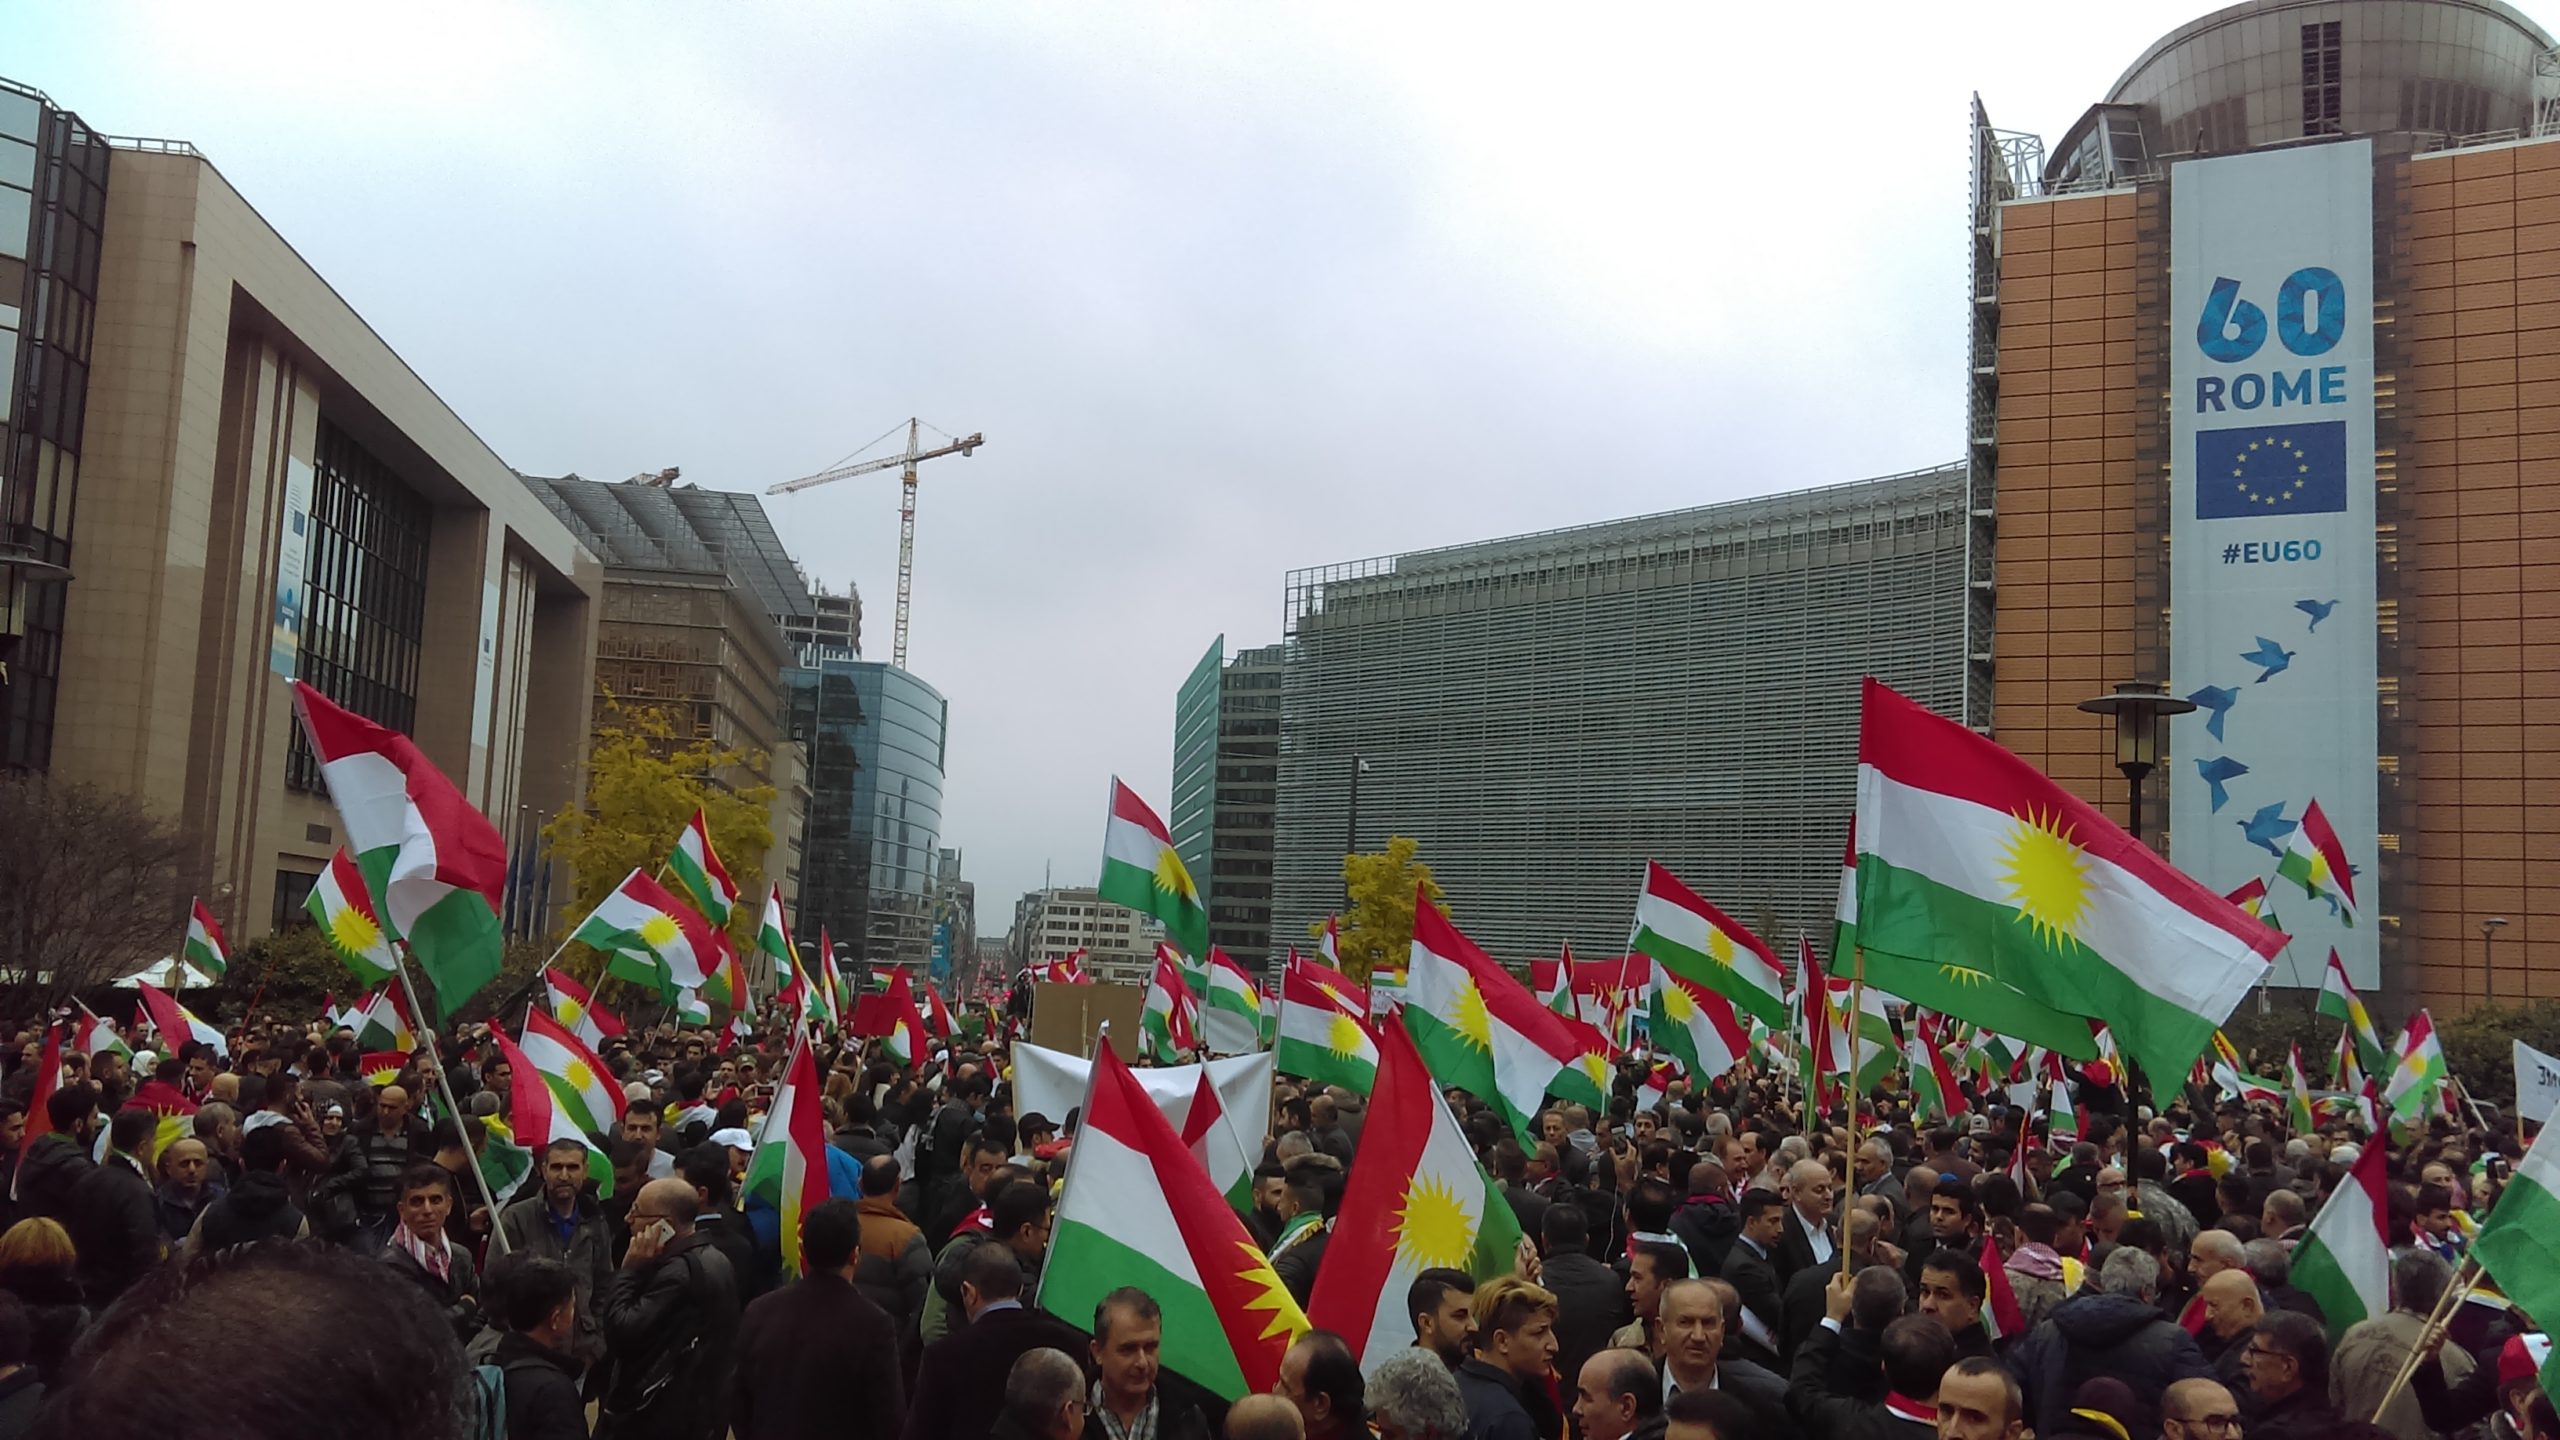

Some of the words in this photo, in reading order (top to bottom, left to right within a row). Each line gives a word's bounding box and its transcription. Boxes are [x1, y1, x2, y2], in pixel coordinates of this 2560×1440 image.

[2196, 266, 2346, 364] 60
[2196, 366, 2347, 414] ROME
[2222, 539, 2322, 565] #EU60
